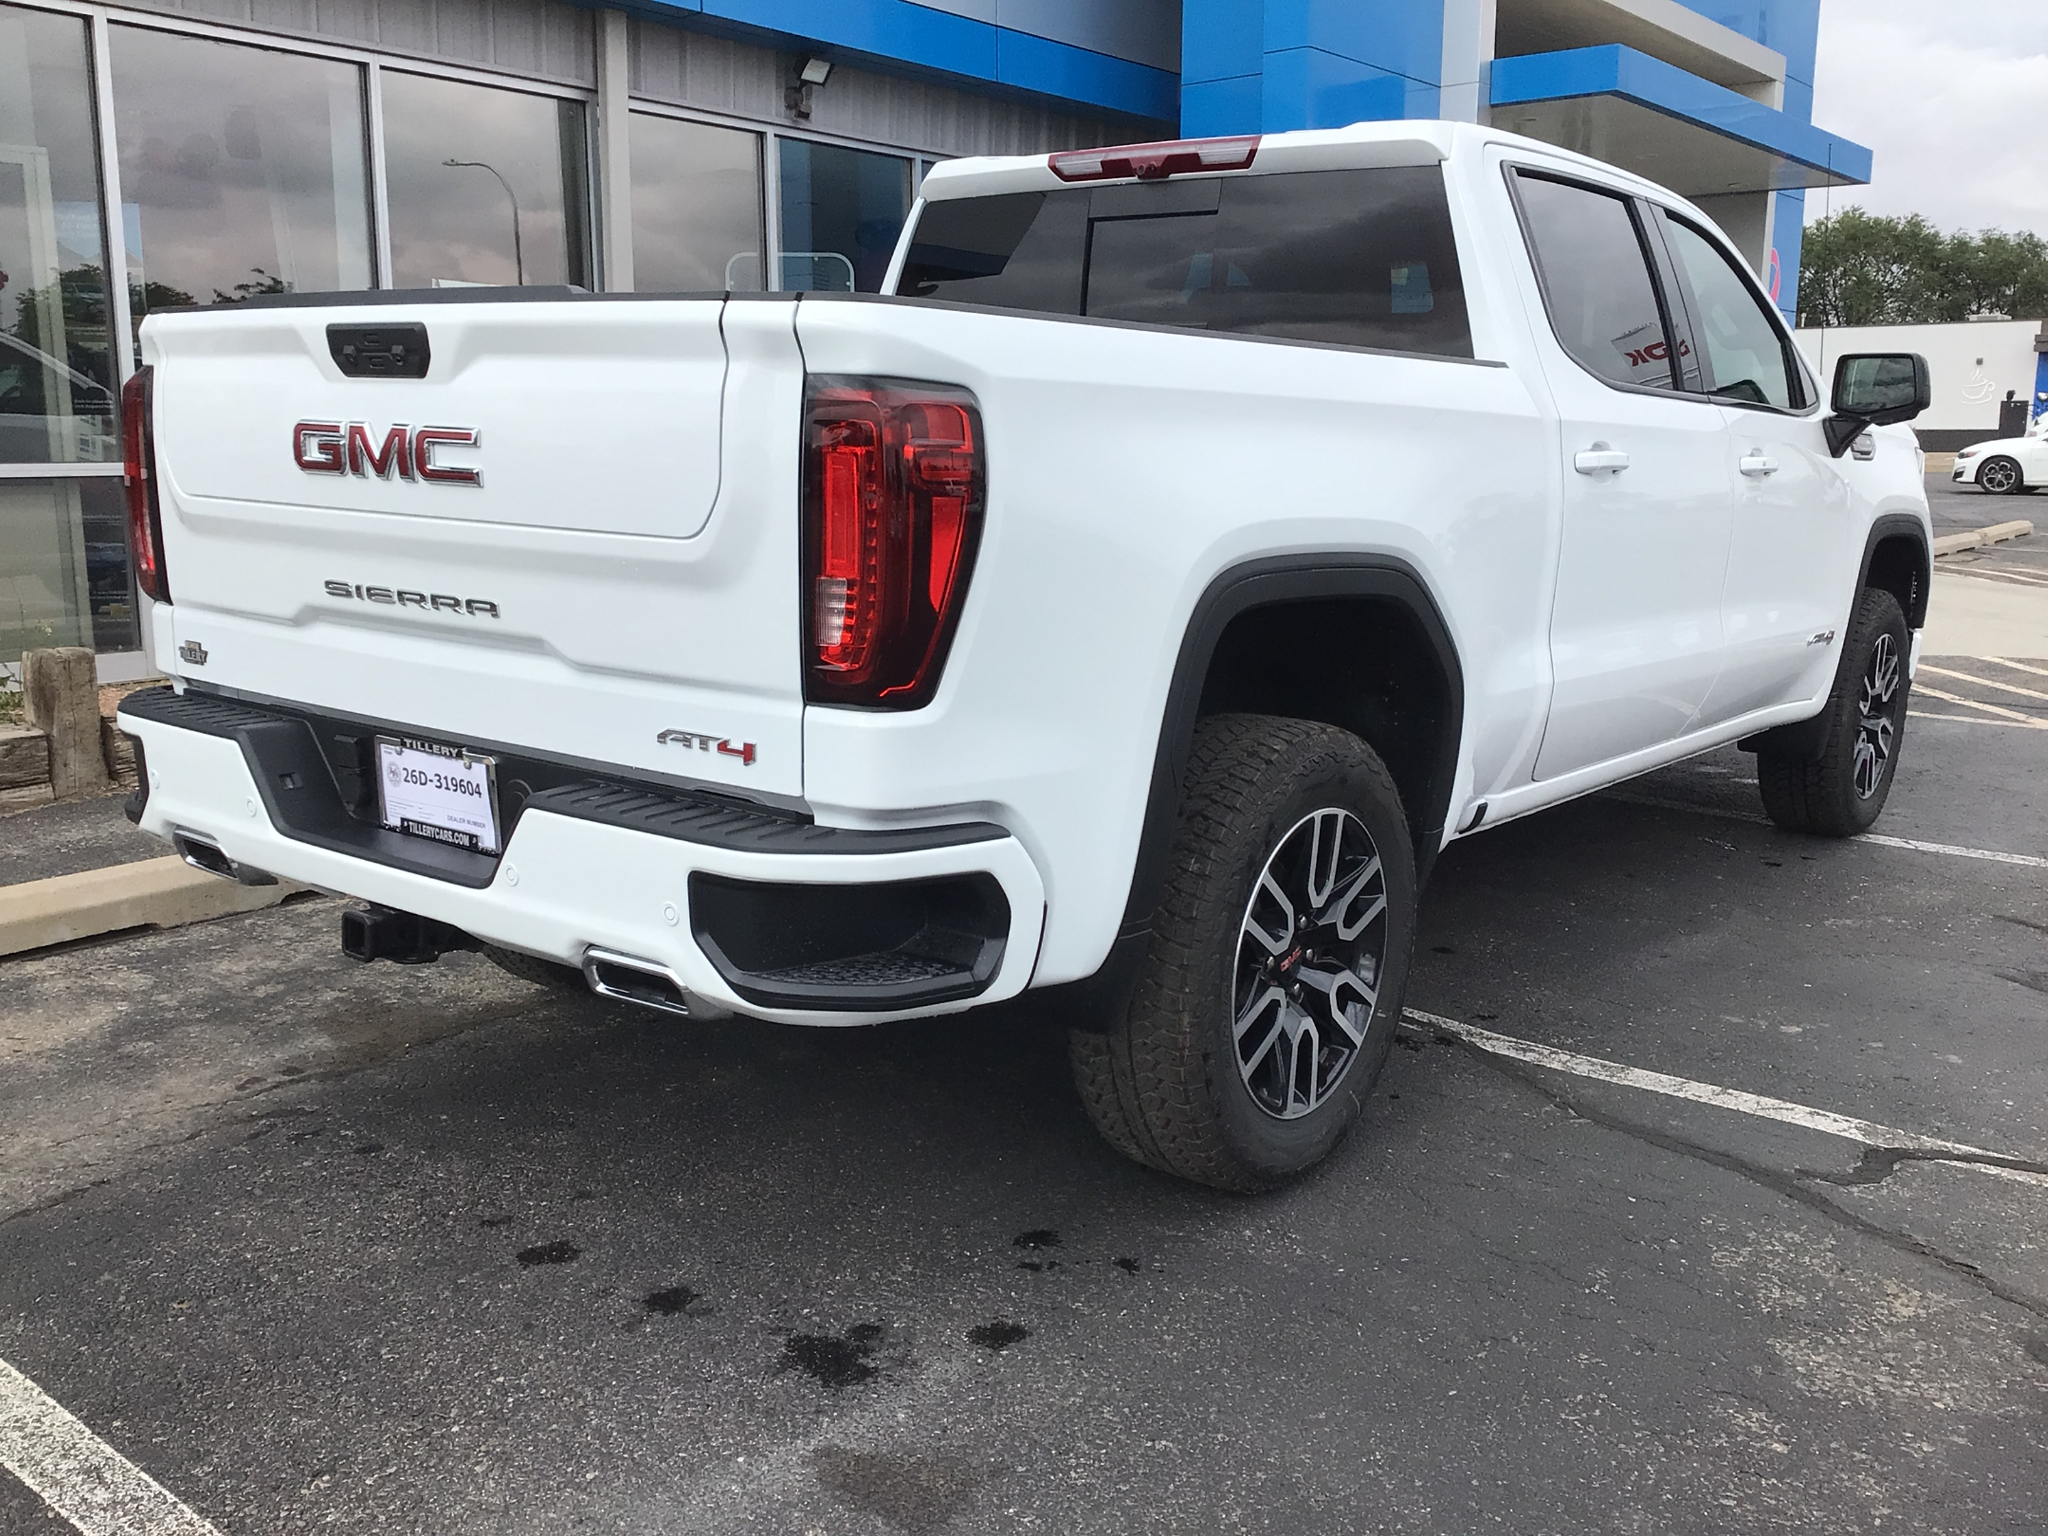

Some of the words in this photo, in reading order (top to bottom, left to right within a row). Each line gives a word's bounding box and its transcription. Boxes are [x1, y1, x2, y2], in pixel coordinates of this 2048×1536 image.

[293, 419, 483, 488] GMC
[324, 579, 501, 619] SIERRA
[403, 739, 459, 757] TILLERY
[657, 728, 757, 766] AT4
[402, 767, 482, 798] 26D-319604
[408, 821, 470, 847] TILLERYCARS.COM
[447, 815, 466, 824] DEALER
[466, 820, 486, 829] NUMBER
